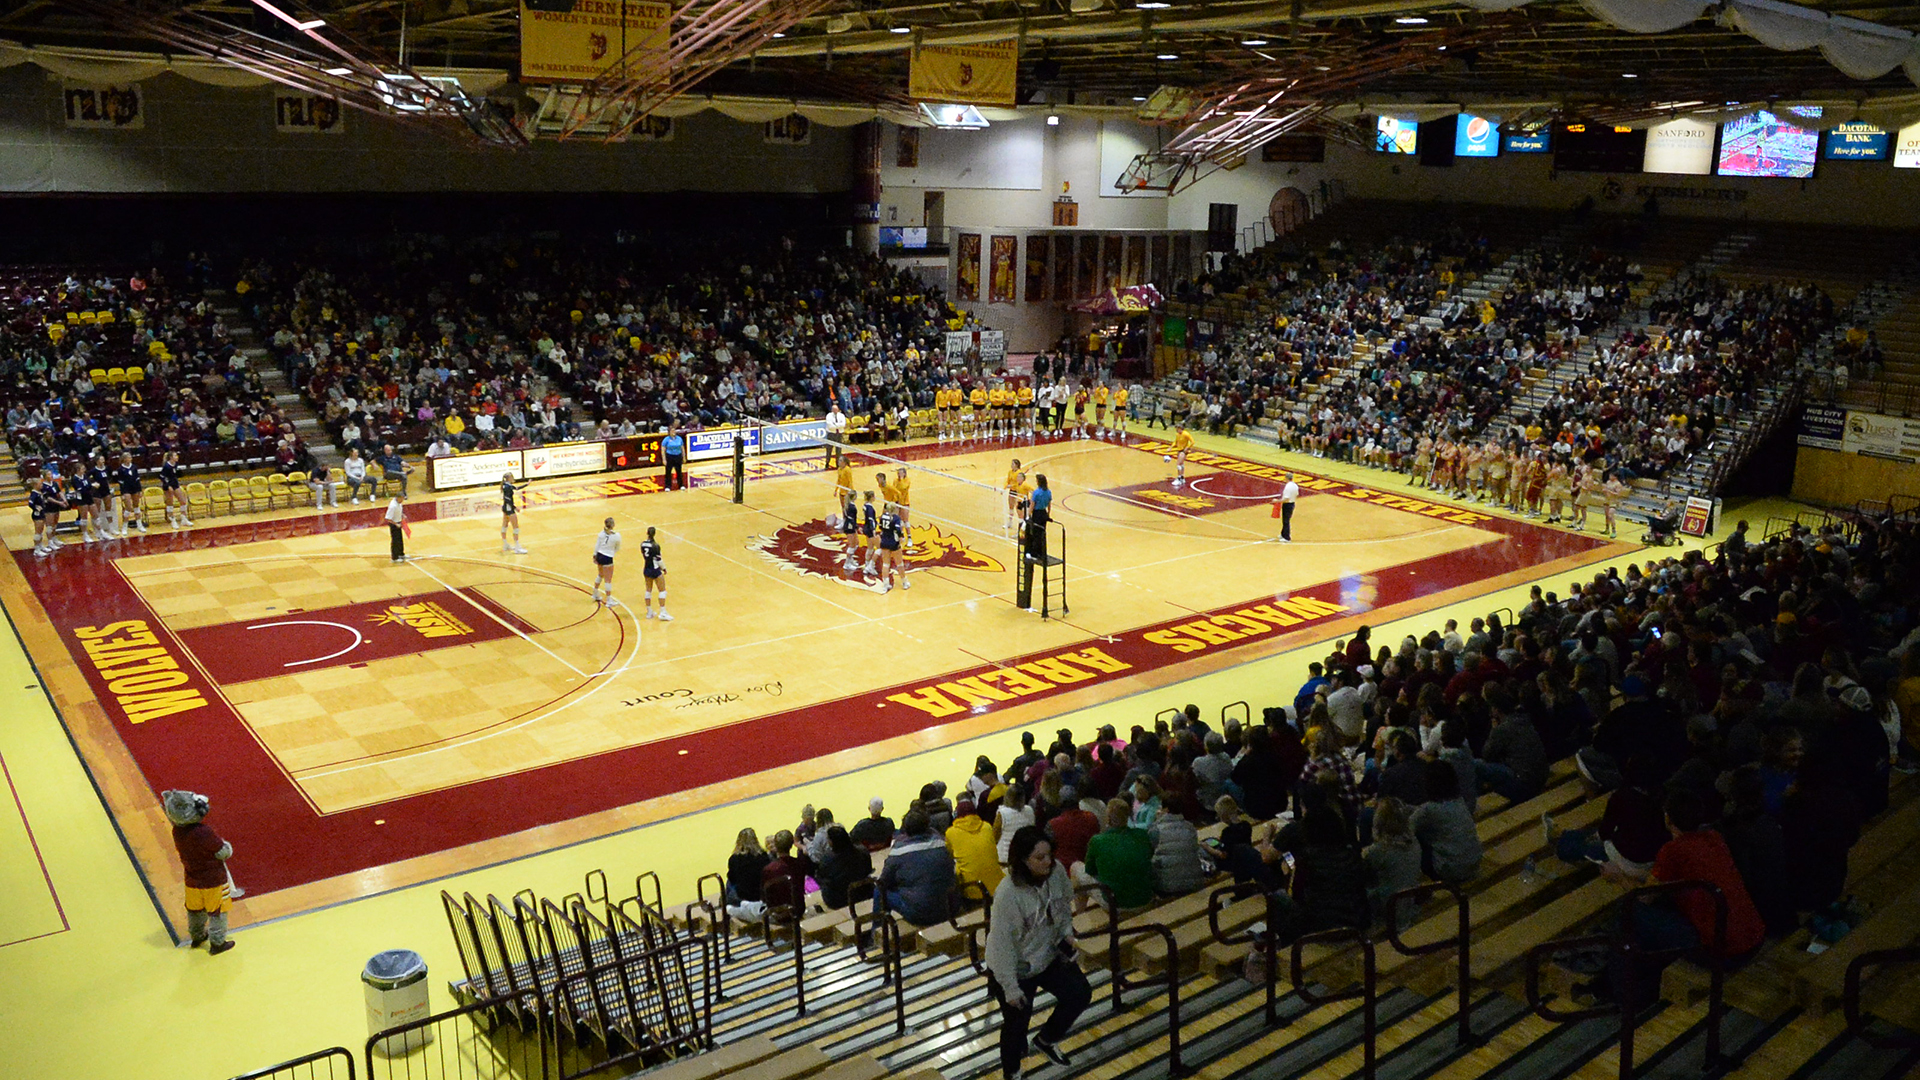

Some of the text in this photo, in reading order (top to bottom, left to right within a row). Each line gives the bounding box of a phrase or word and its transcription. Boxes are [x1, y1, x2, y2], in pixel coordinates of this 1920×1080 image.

[534, 11, 659, 30] WOMEN'S BASKETBALL
[1657, 130, 1705, 138] SANFORD
[765, 428, 827, 445] SANFORD
[472, 462, 506, 471] Andersen
[1337, 487, 1493, 525] STATE
[882, 519, 891, 529] 12
[644, 547, 650, 557] 2
[389, 604, 462, 638] NSIC
[885, 596, 1350, 718] WACHS ARENA
[73, 619, 208, 725] WOLVES
[620, 688, 694, 707] Court
